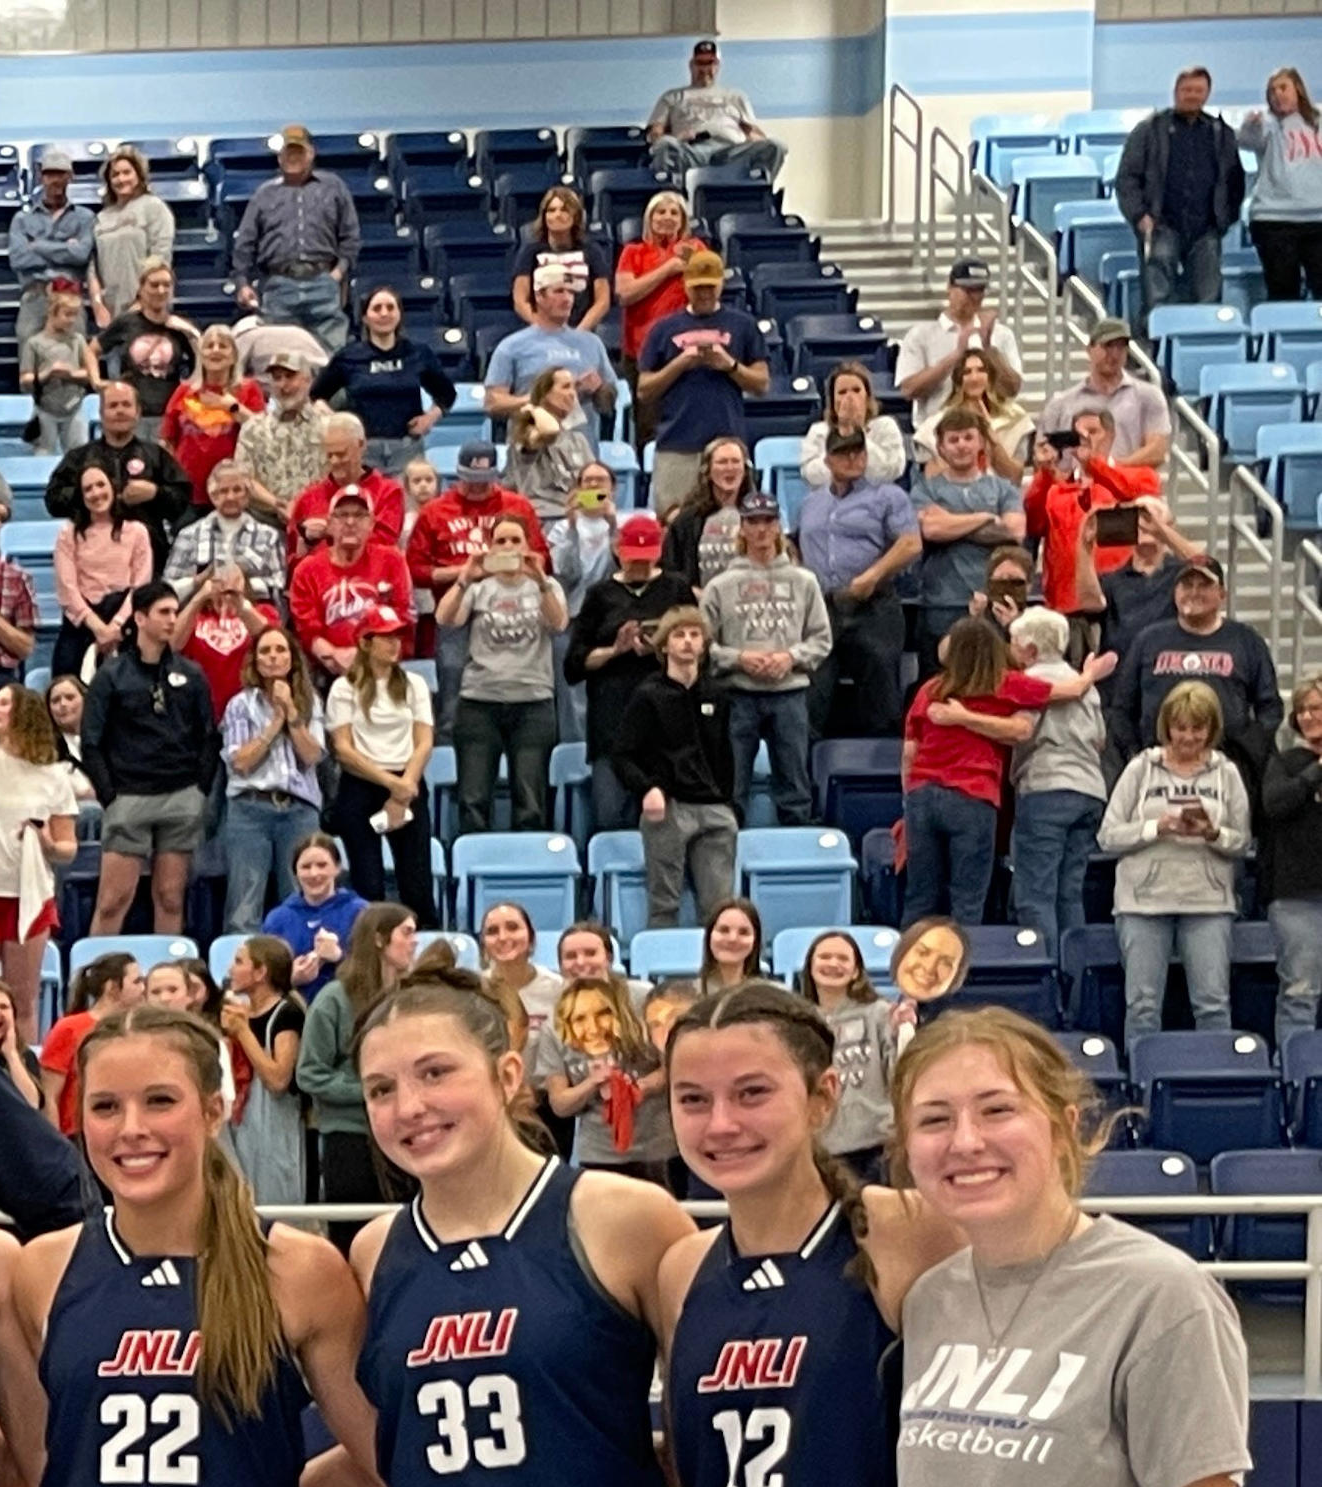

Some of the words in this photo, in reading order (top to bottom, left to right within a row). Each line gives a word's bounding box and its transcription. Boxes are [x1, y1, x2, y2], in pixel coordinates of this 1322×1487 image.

[97, 1329, 205, 1377] JNLI
[406, 1307, 519, 1368] JNLI
[697, 1336, 808, 1393] JNLI
[899, 1343, 1087, 1421] JNLI
[99, 1393, 201, 1486] 22
[417, 1374, 527, 1475] 33
[898, 1421, 1055, 1465] sketball
